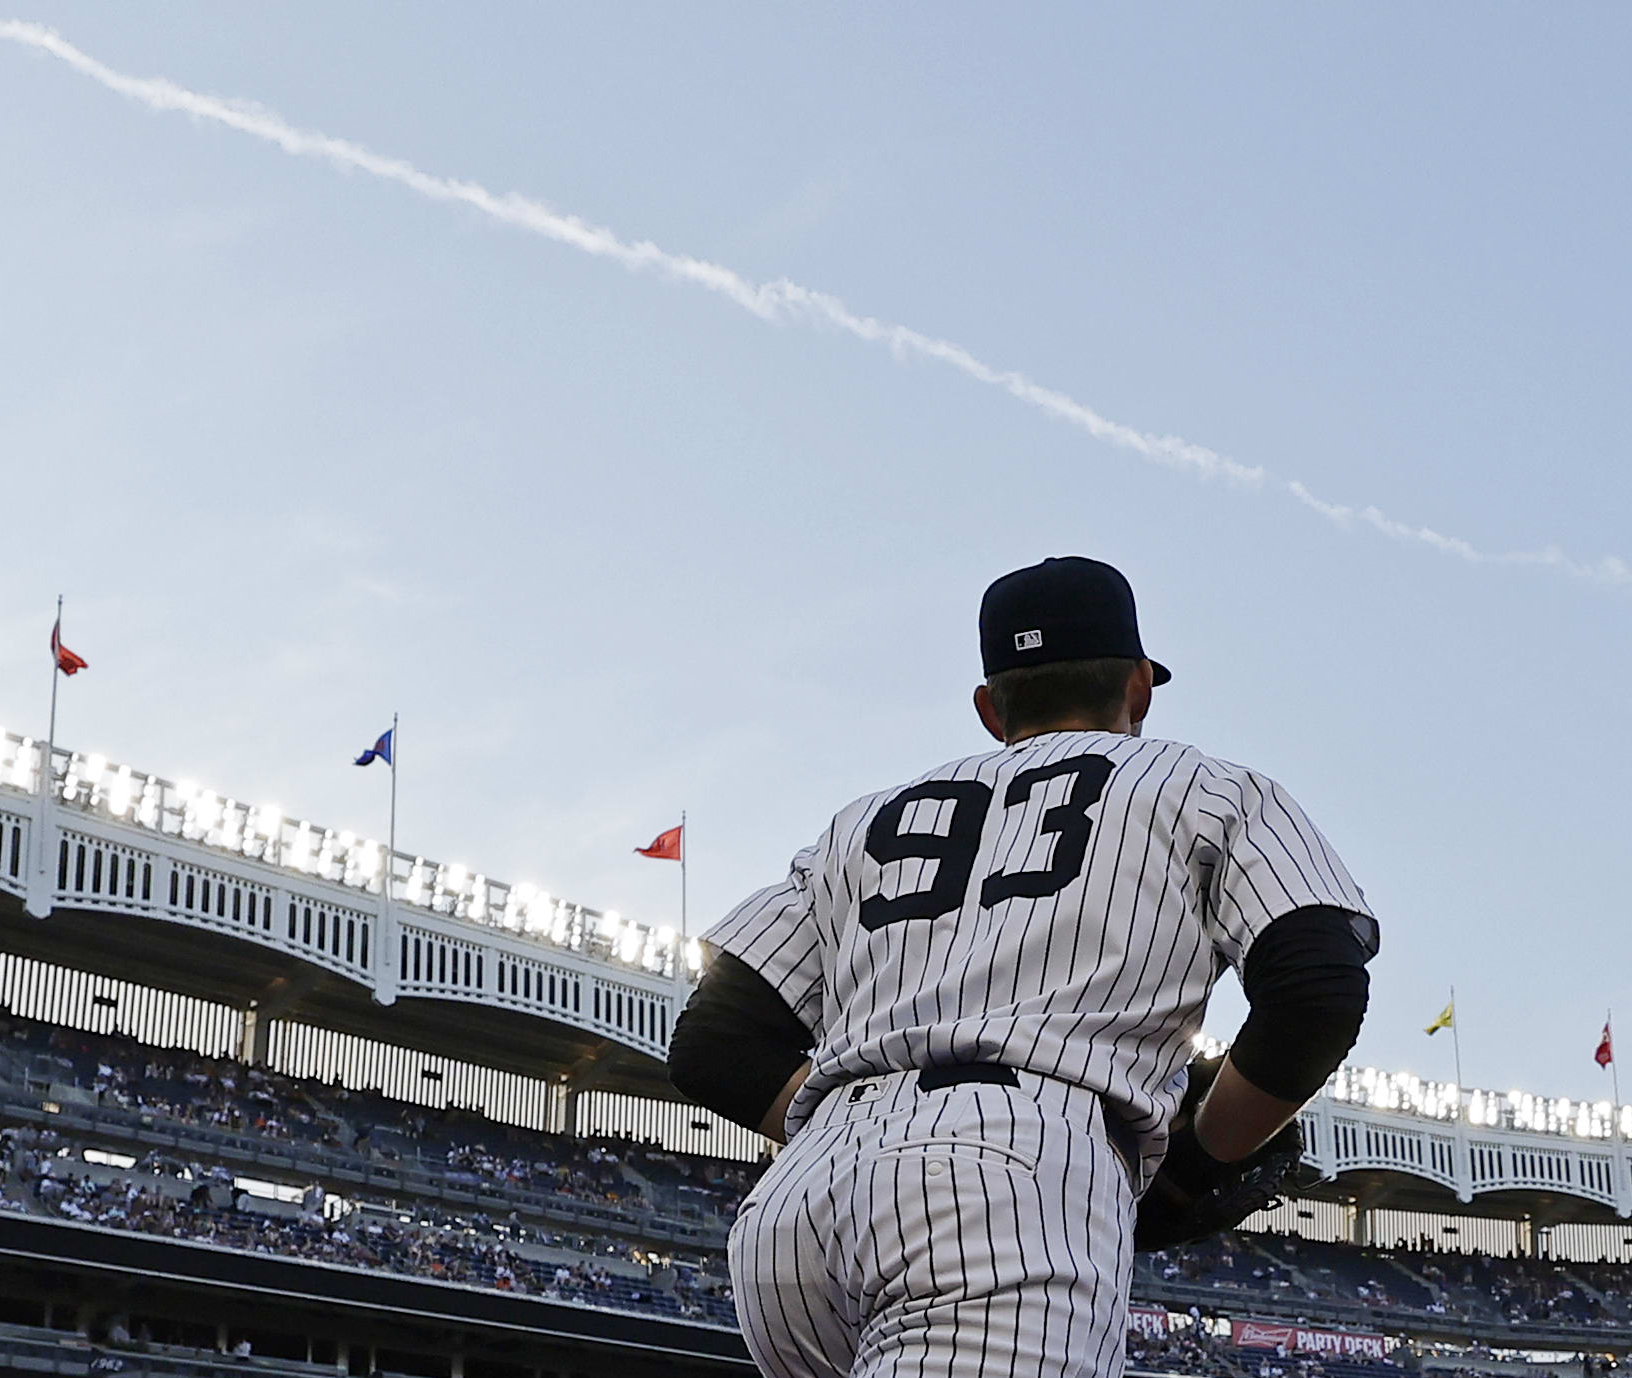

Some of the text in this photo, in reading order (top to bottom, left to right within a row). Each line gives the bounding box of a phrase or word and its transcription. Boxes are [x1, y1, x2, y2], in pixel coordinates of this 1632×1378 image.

[860, 752, 1116, 933] 93
[1297, 1331, 1342, 1354] PARTY
[1344, 1336, 1383, 1359] DECK
